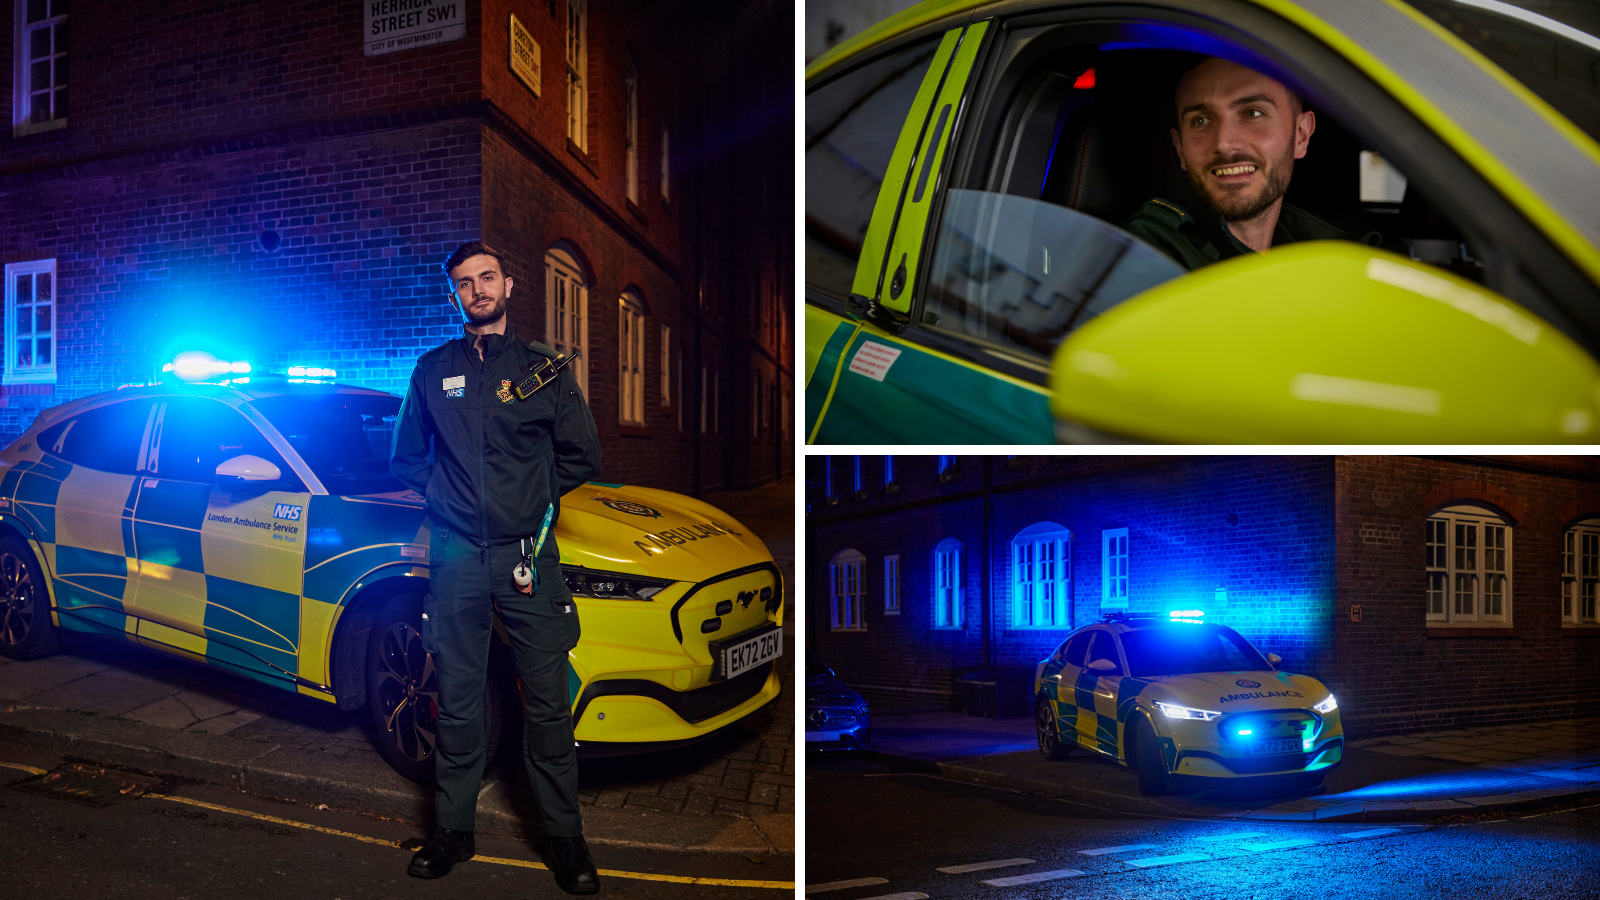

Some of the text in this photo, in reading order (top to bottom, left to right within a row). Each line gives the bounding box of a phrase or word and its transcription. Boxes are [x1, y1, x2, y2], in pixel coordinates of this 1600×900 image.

[372, 3, 456, 35] STREET SW1
[371, 30, 443, 51] CITY OF WESTMINSTER
[514, 39, 531, 67] STREET
[446, 389, 463, 397] NHS
[274, 504, 301, 520] NHS
[208, 512, 298, 534] London Ambulance Service
[272, 533, 297, 543] NHS Trust
[731, 631, 779, 673] EK72 ZGV
[1220, 691, 1305, 704] AMBULANCE
[1253, 739, 1300, 754] EK72 ZGV
